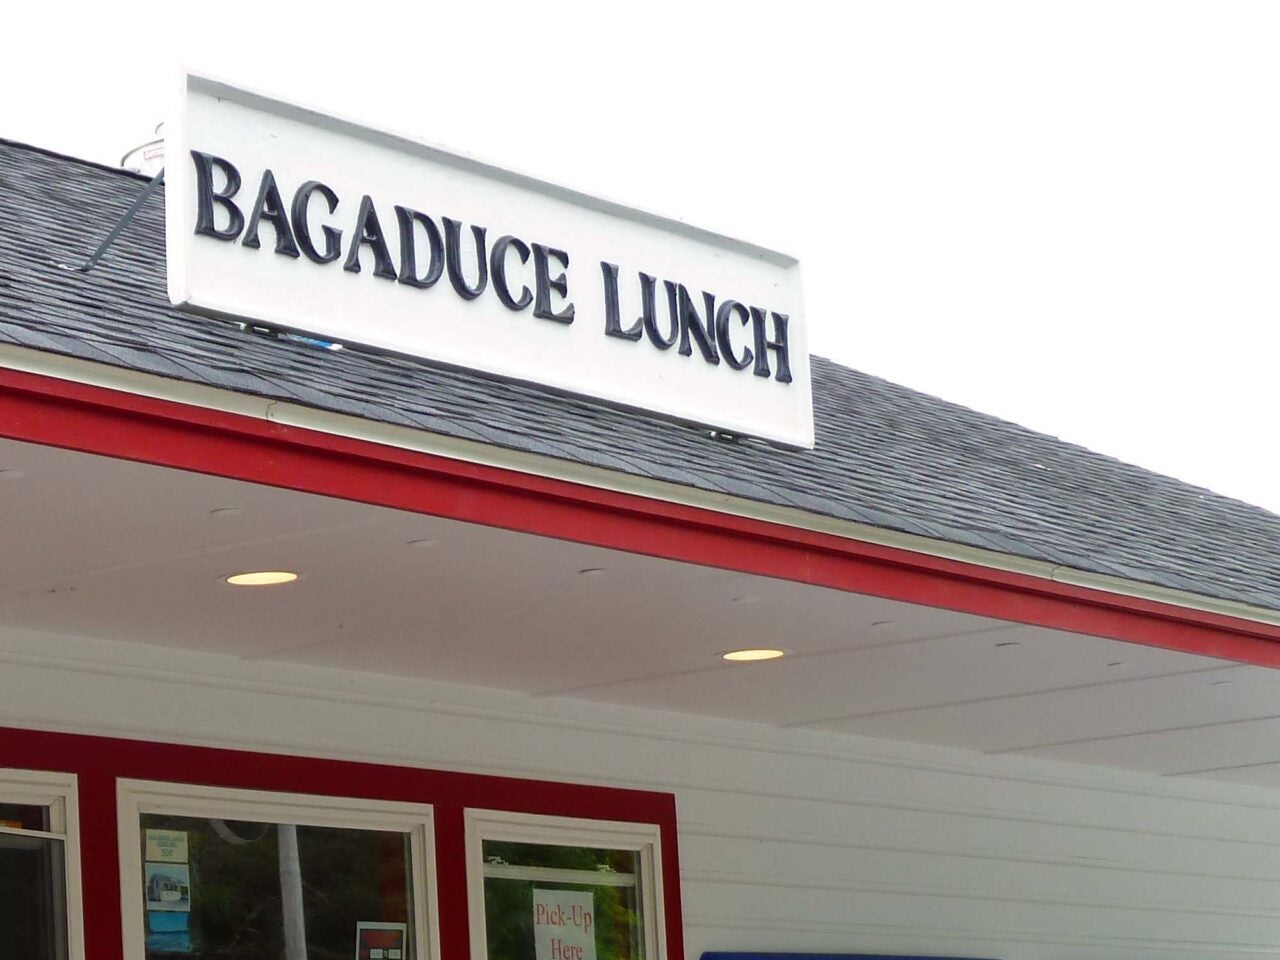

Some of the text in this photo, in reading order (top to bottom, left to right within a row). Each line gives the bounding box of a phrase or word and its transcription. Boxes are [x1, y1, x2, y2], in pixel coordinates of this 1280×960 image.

[190, 149, 793, 384] BAGADUCE LUNCH
[535, 903, 593, 932] Pick-Up
[550, 938, 583, 960] Here
